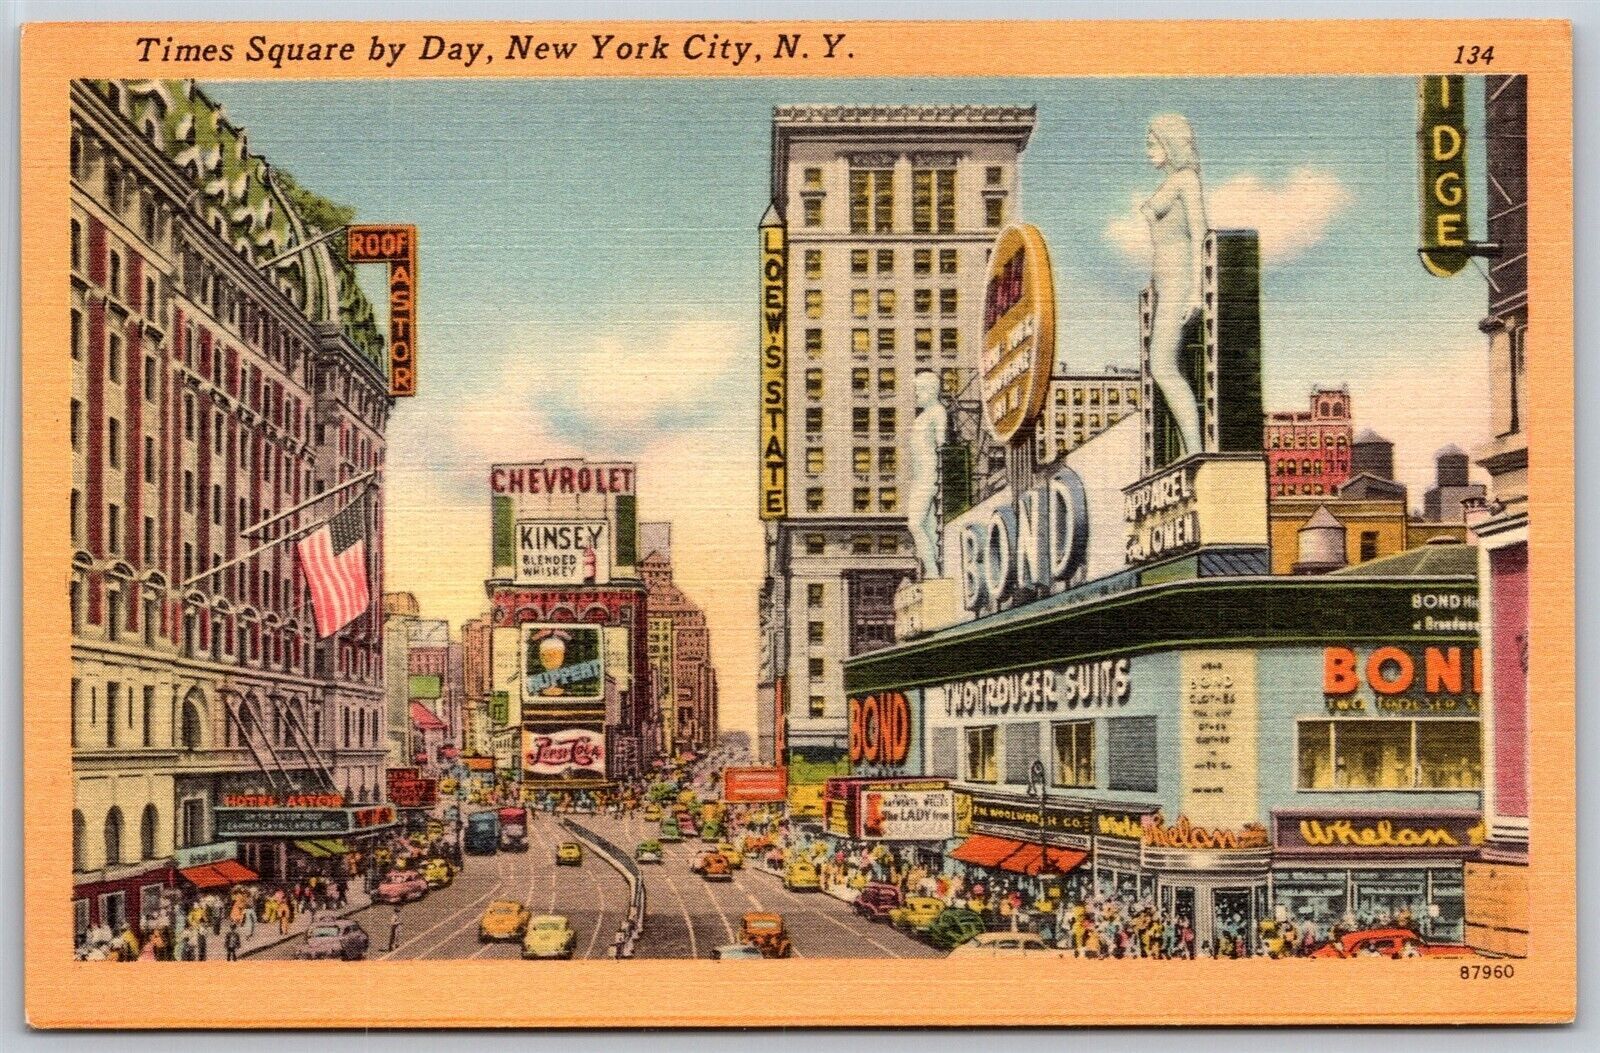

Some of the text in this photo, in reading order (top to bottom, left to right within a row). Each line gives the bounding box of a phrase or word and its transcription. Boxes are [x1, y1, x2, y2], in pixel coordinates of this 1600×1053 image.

[137, 34, 854, 68] Times Square by Day, New York City, N. Y.
[1453, 45, 1495, 65] 134
[350, 233, 408, 255] ROOF
[764, 231, 784, 369] LOEW'S
[390, 266, 410, 388] ASTOR
[764, 381, 784, 513] STATE
[491, 467, 633, 493] CHEVROLET
[1125, 469, 1191, 521] APPAREL
[520, 525, 603, 550] KINSEY
[961, 460, 1086, 606] BOND
[522, 554, 577, 565] BLENDED
[522, 566, 576, 577] WHISKEY
[1411, 593, 1461, 609] BOND
[1064, 659, 1130, 706] SUITS
[849, 691, 909, 763] BOND
[900, 808, 931, 822] LADY
[1300, 819, 1459, 846] Whelan
[1460, 964, 1515, 980] 87960
